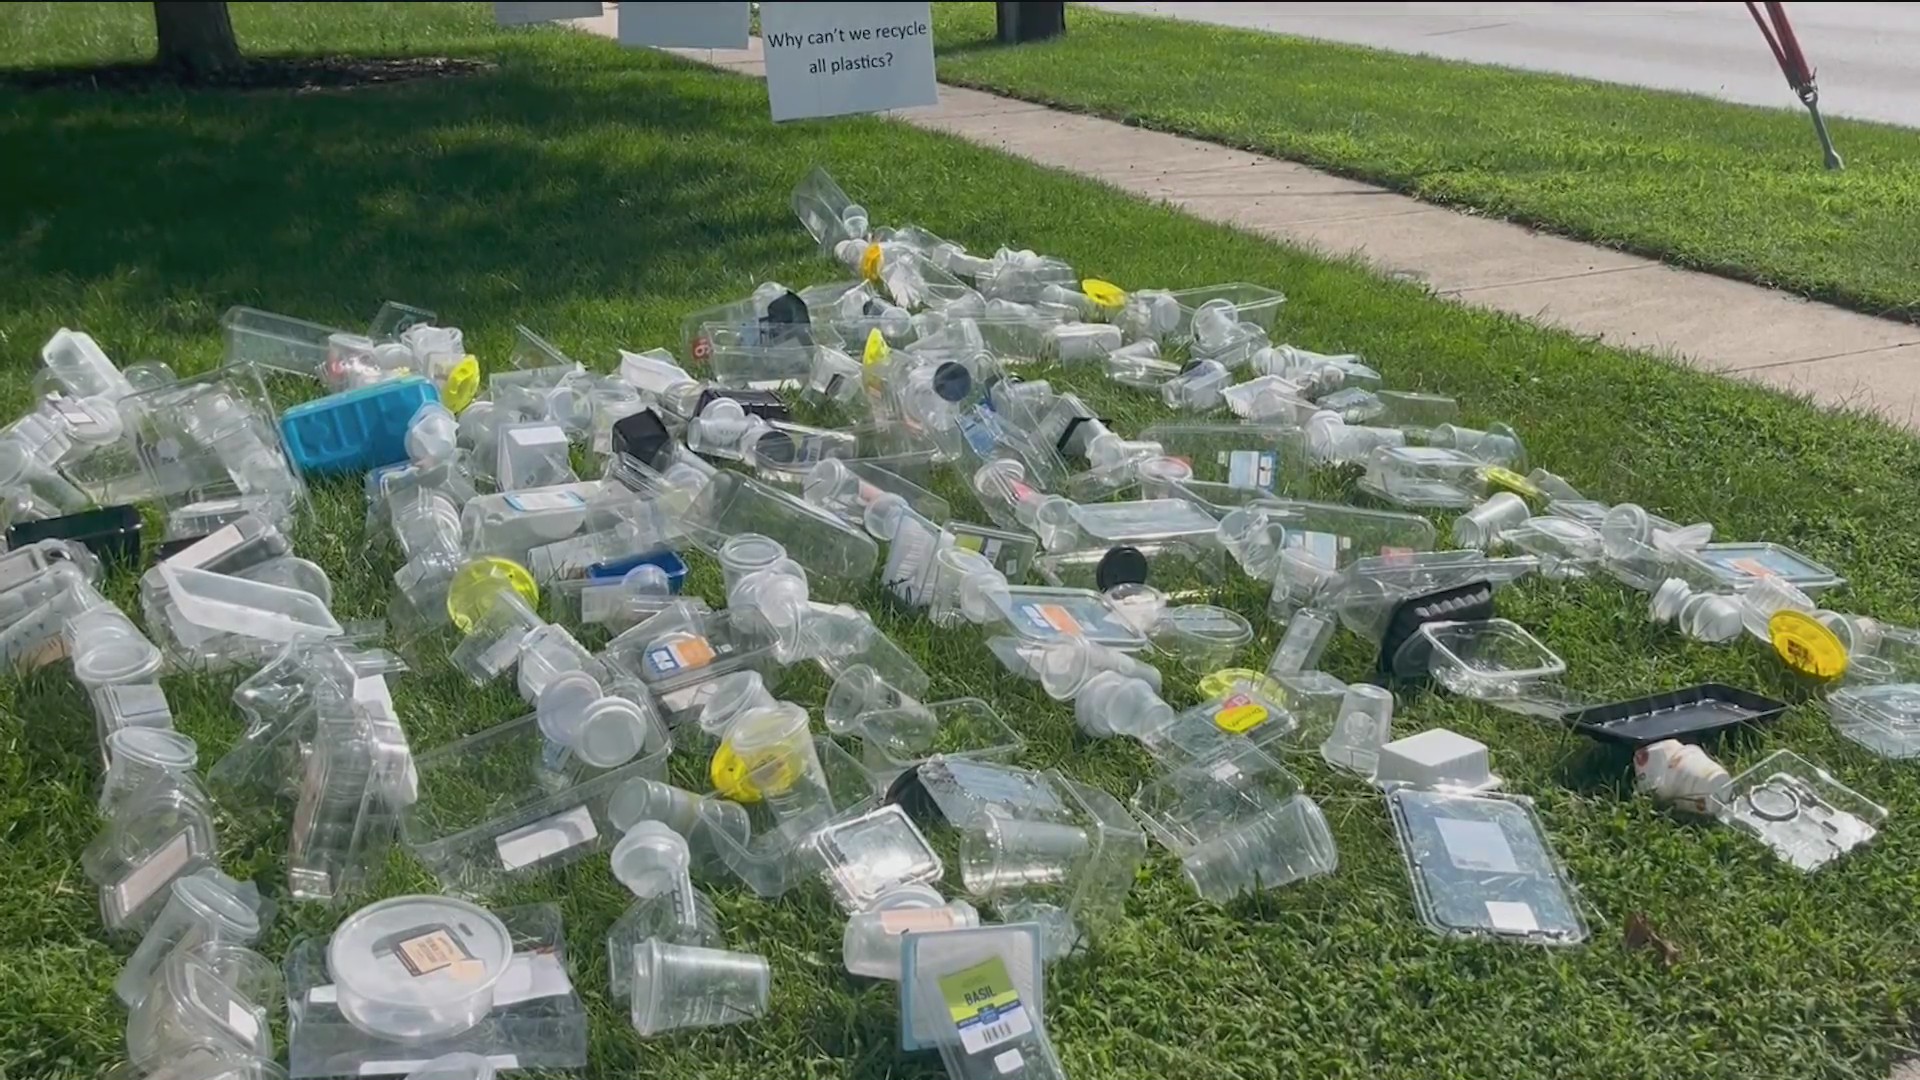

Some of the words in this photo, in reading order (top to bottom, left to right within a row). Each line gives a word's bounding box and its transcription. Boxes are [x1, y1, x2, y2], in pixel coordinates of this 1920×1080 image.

[767, 32, 803, 49] Why
[807, 27, 846, 45] can’t
[850, 29, 872, 41] we
[876, 21, 928, 40] recycle
[809, 58, 827, 74] all
[831, 51, 894, 75] plastics?
[963, 985, 998, 1006] BASIL
